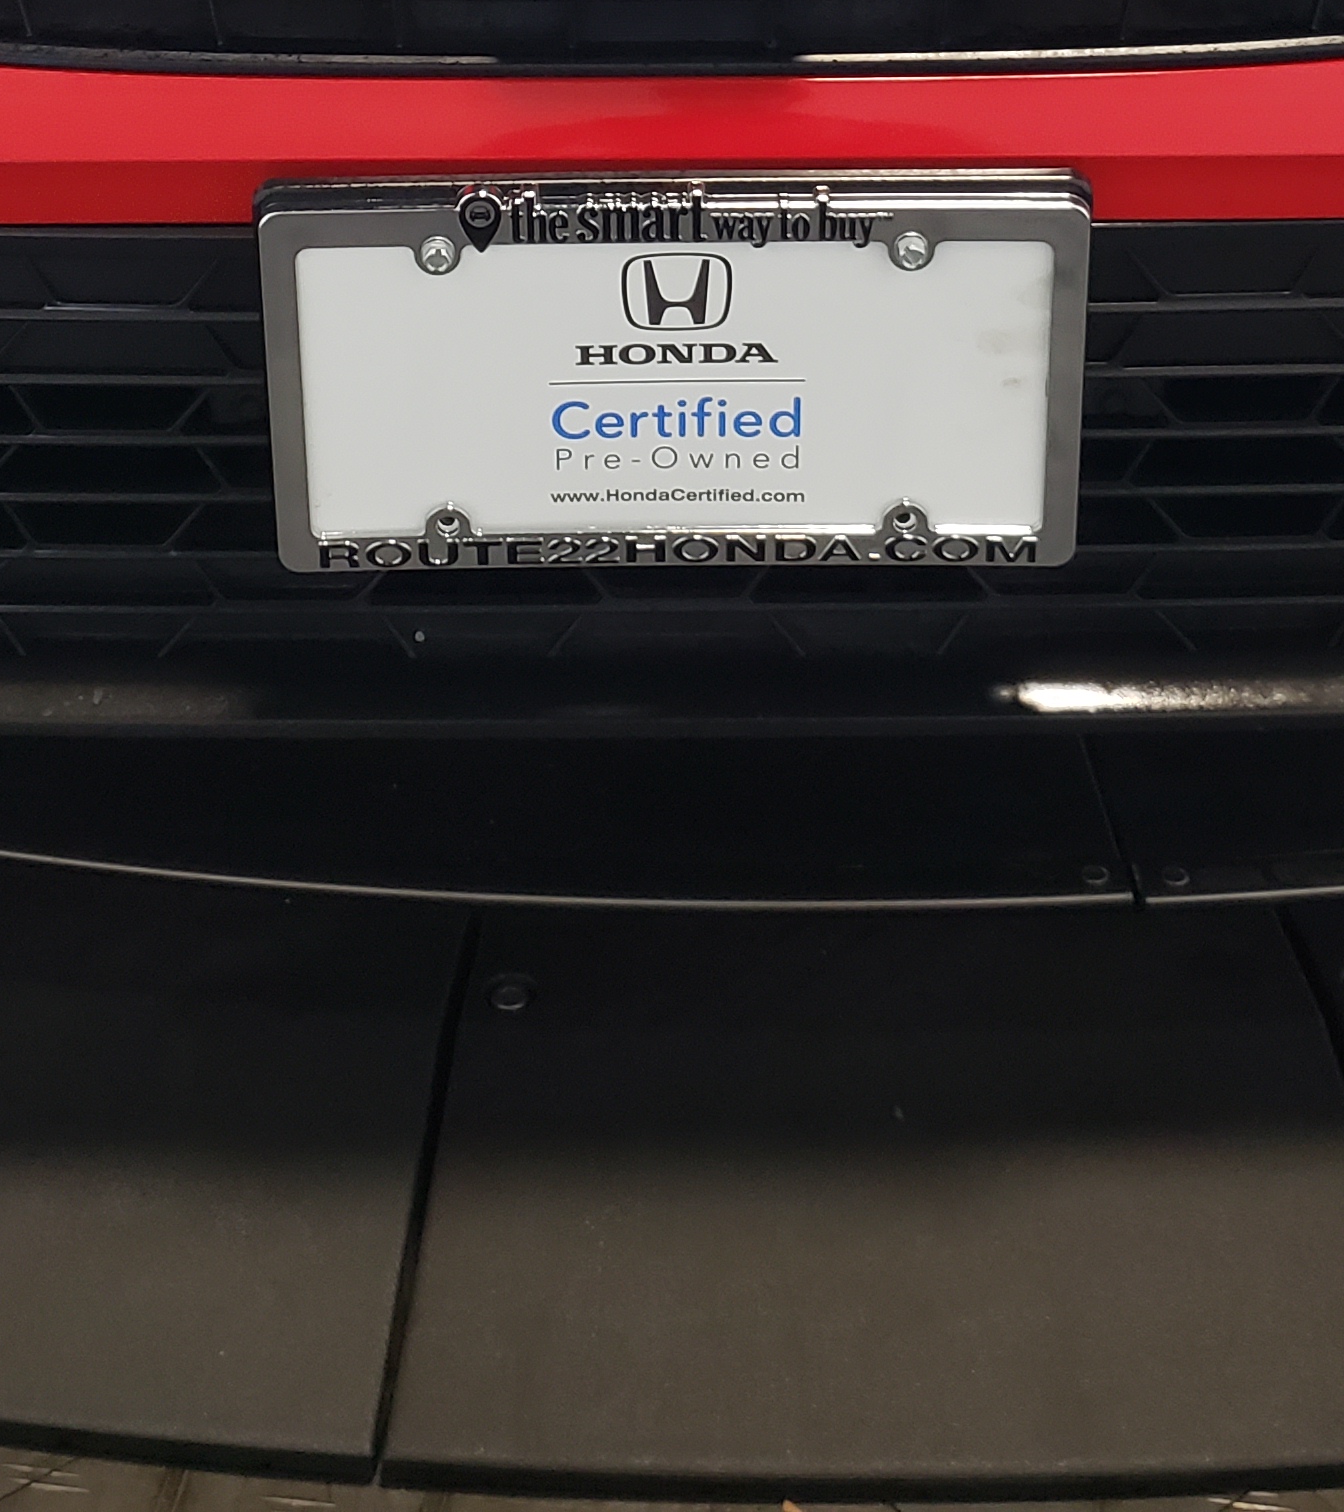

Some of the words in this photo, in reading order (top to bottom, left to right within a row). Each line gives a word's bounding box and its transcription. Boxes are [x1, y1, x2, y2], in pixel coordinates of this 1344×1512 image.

[510, 189, 569, 243] the
[576, 190, 706, 243] smart
[710, 213, 775, 248] way
[777, 199, 811, 240] to
[575, 342, 779, 366] HONDA
[551, 396, 802, 439] Certified
[555, 445, 800, 471] Pre-Owned
[550, 488, 806, 503] www.HondaCertified.com
[317, 534, 1039, 568] ROUTE22HONDA.COM
